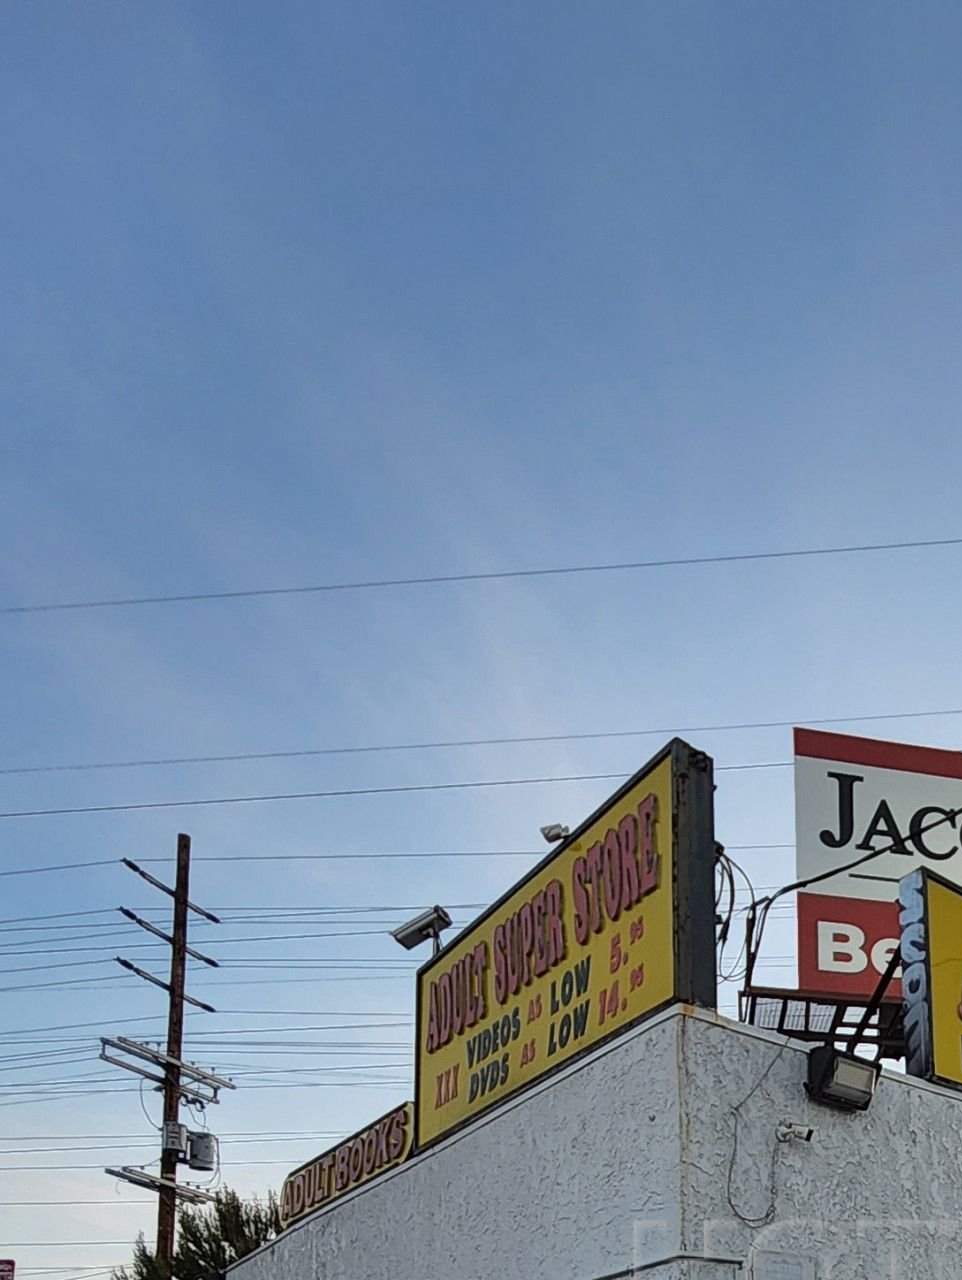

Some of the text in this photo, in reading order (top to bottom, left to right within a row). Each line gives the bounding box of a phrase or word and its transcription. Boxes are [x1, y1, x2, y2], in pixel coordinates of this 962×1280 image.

[426, 793, 660, 1055] ADULT SUPER STORE
[466, 1006, 521, 1070] VIDEOS
[526, 994, 543, 1025] AS
[550, 954, 593, 1016] LOW
[468, 1051, 510, 1105] DVDS
[520, 1038, 536, 1068] AS
[546, 998, 591, 1058] LOW
[282, 1109, 408, 1222] ADULT BOOKS
